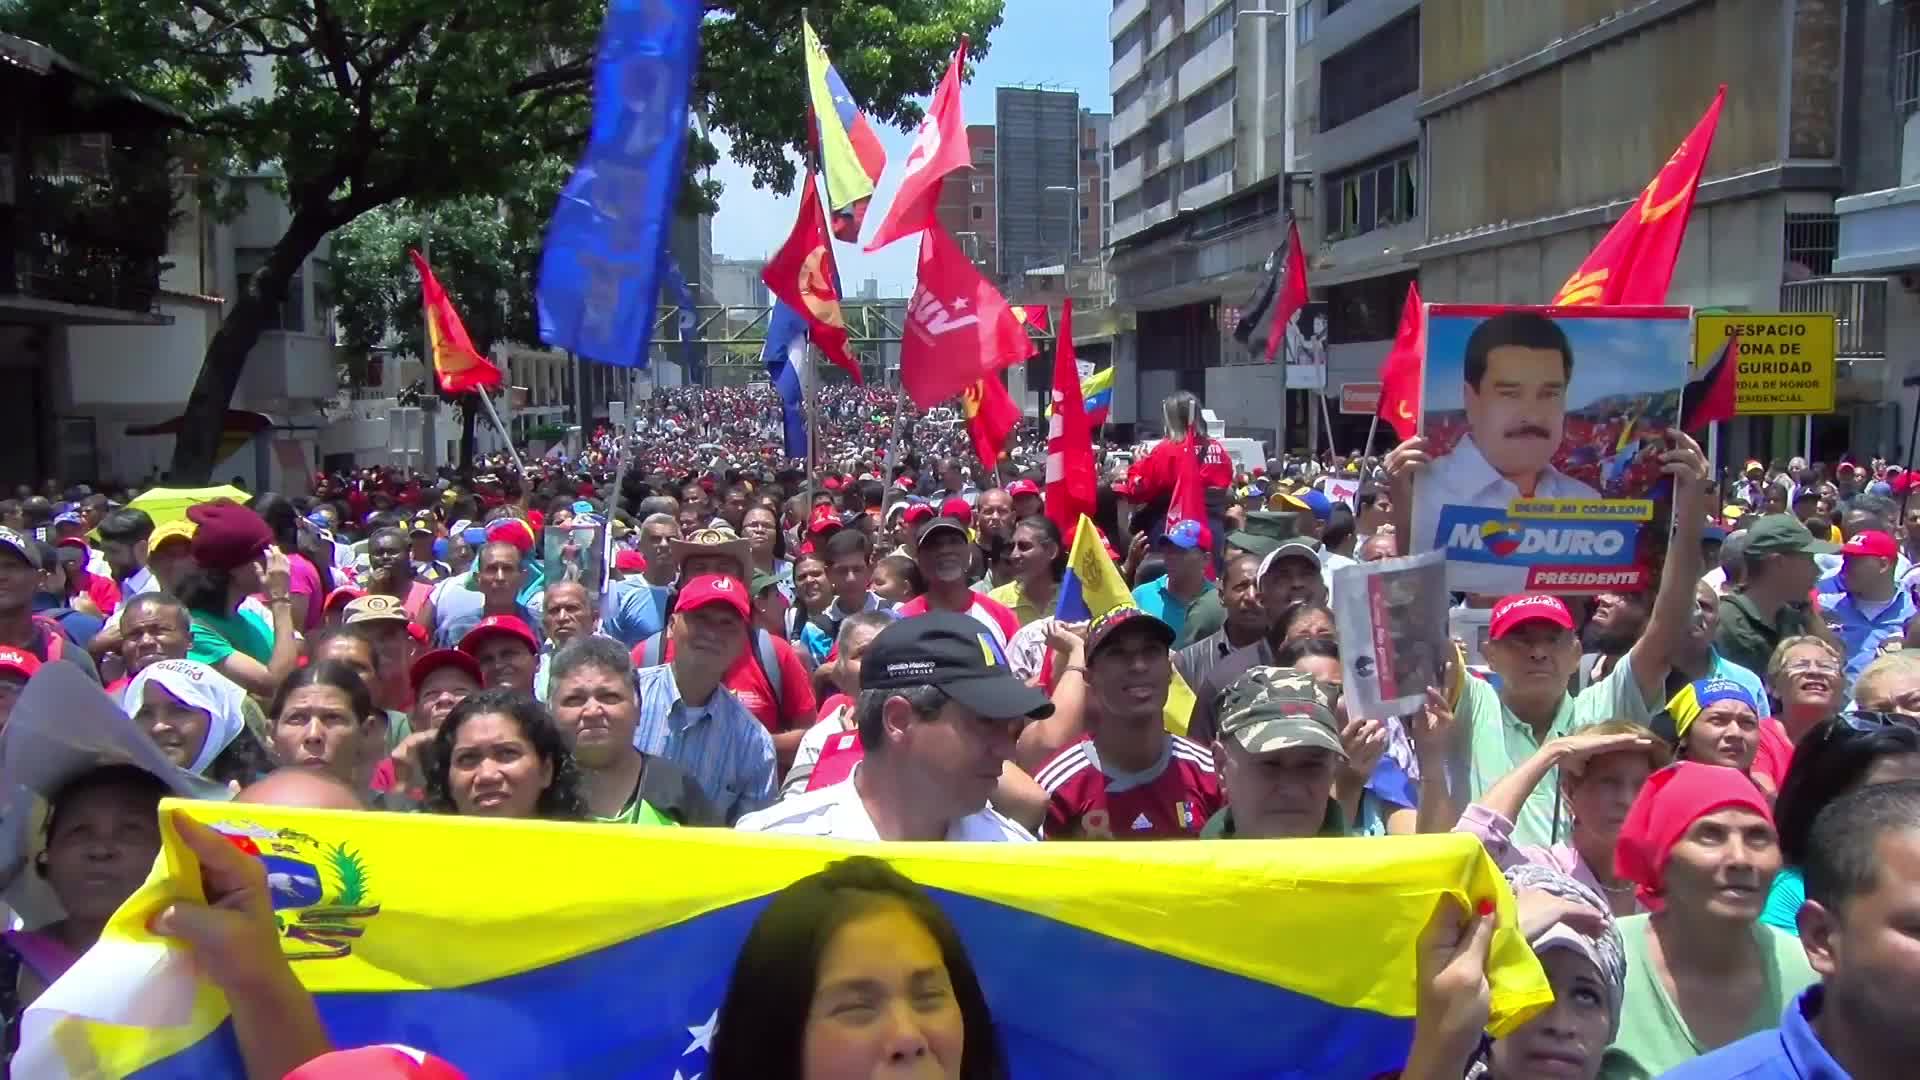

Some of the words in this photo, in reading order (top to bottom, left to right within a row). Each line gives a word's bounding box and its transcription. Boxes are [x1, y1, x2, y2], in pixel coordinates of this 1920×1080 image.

[1724, 324, 1806, 337] DESPACIO
[1736, 343, 1775, 355] ONA
[1780, 343, 1801, 355] DE
[1737, 361, 1813, 375] GURIDAD
[1779, 380, 1819, 389] HONOR
[1447, 521, 1625, 557] MDURO
[1534, 571, 1640, 585] PRESIDENTE
